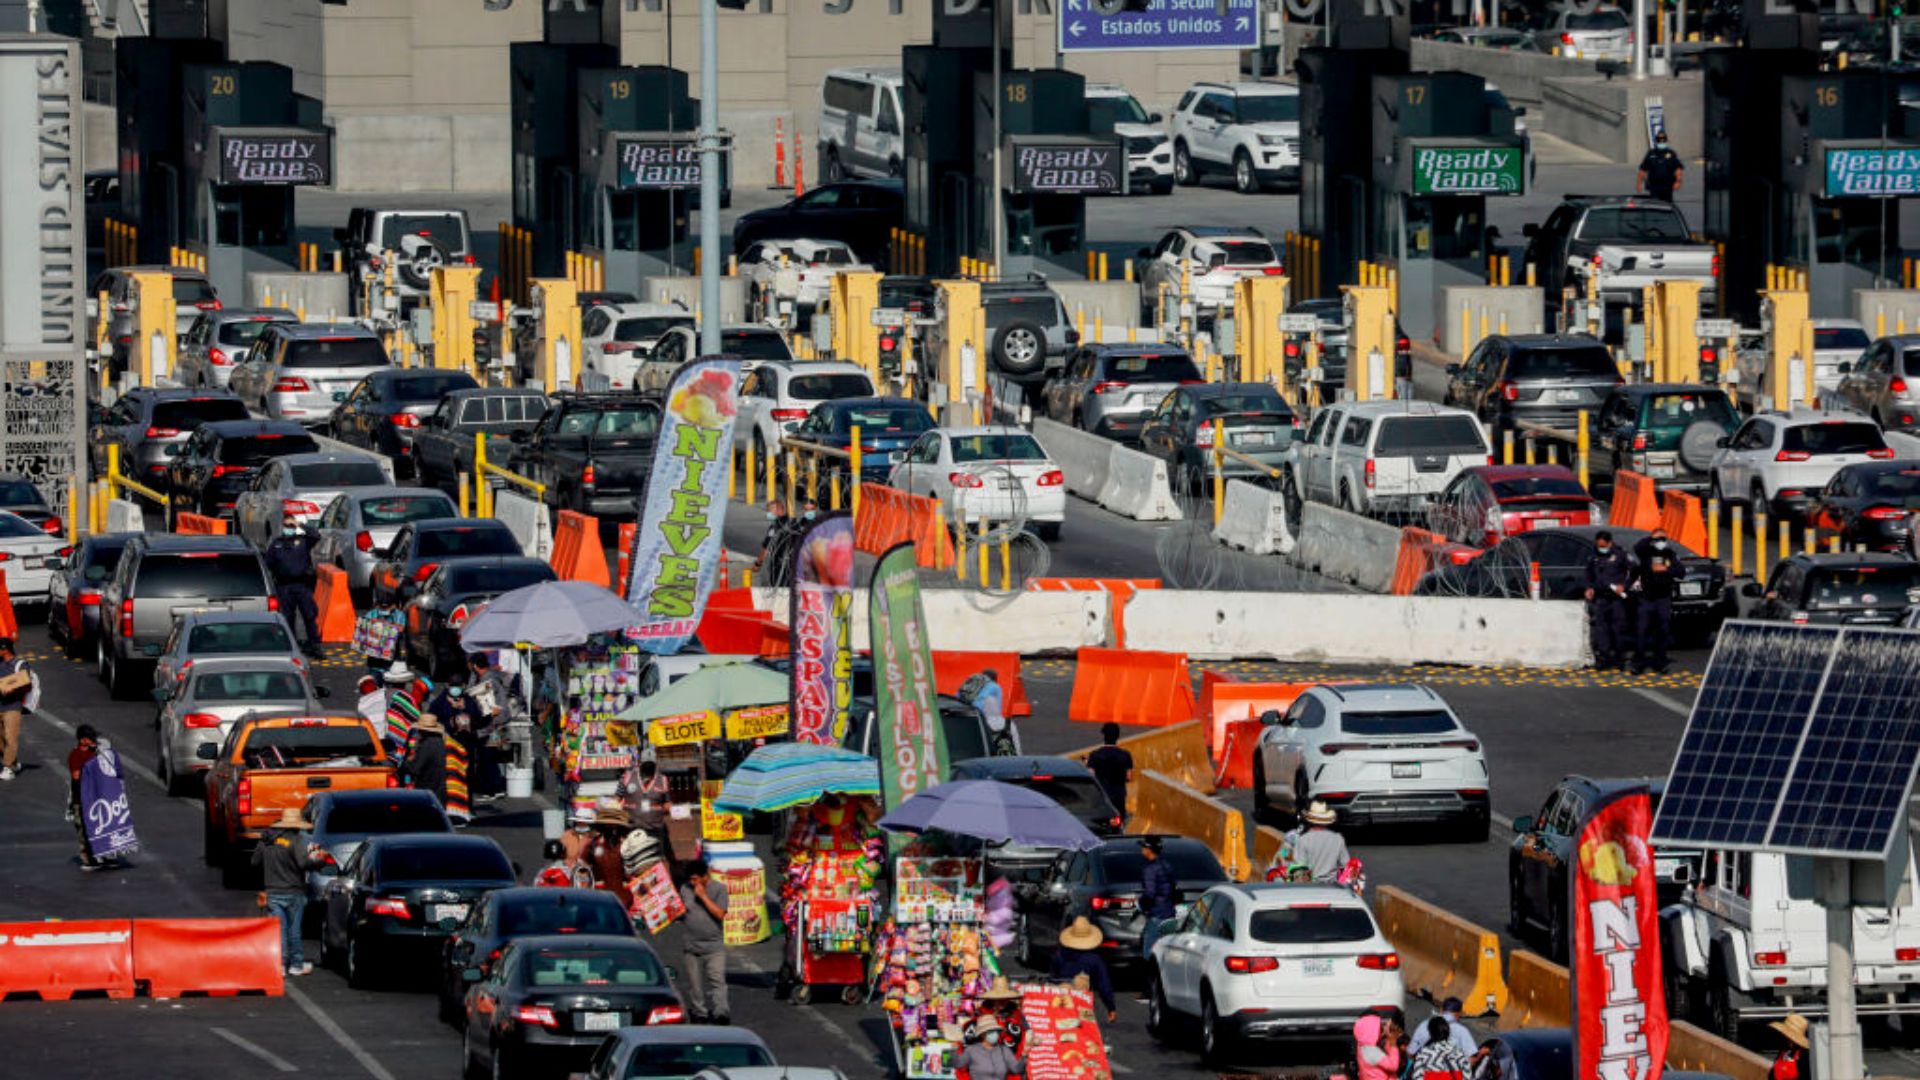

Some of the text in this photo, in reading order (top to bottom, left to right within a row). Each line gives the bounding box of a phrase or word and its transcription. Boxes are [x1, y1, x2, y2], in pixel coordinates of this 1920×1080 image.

[1102, 17, 1222, 35] Estados Unidos
[211, 75, 235, 95] 20
[609, 80, 630, 99] 19
[1006, 84, 1027, 102] 18
[1407, 86, 1424, 105] 17
[1816, 88, 1838, 106] 16
[226, 139, 316, 167] Ready
[623, 143, 702, 172] Read
[1020, 147, 1109, 175] Ready
[1419, 149, 1509, 178] Ready
[238, 159, 307, 181] Lane
[636, 164, 702, 185] Lane
[1031, 168, 1100, 189] Lane
[1431, 170, 1500, 192] Lane
[1844, 172, 1914, 195] Lane
[37, 54, 74, 344] UNITED STATES
[648, 423, 723, 618] NIEVES
[665, 721, 706, 741] ELOTE
